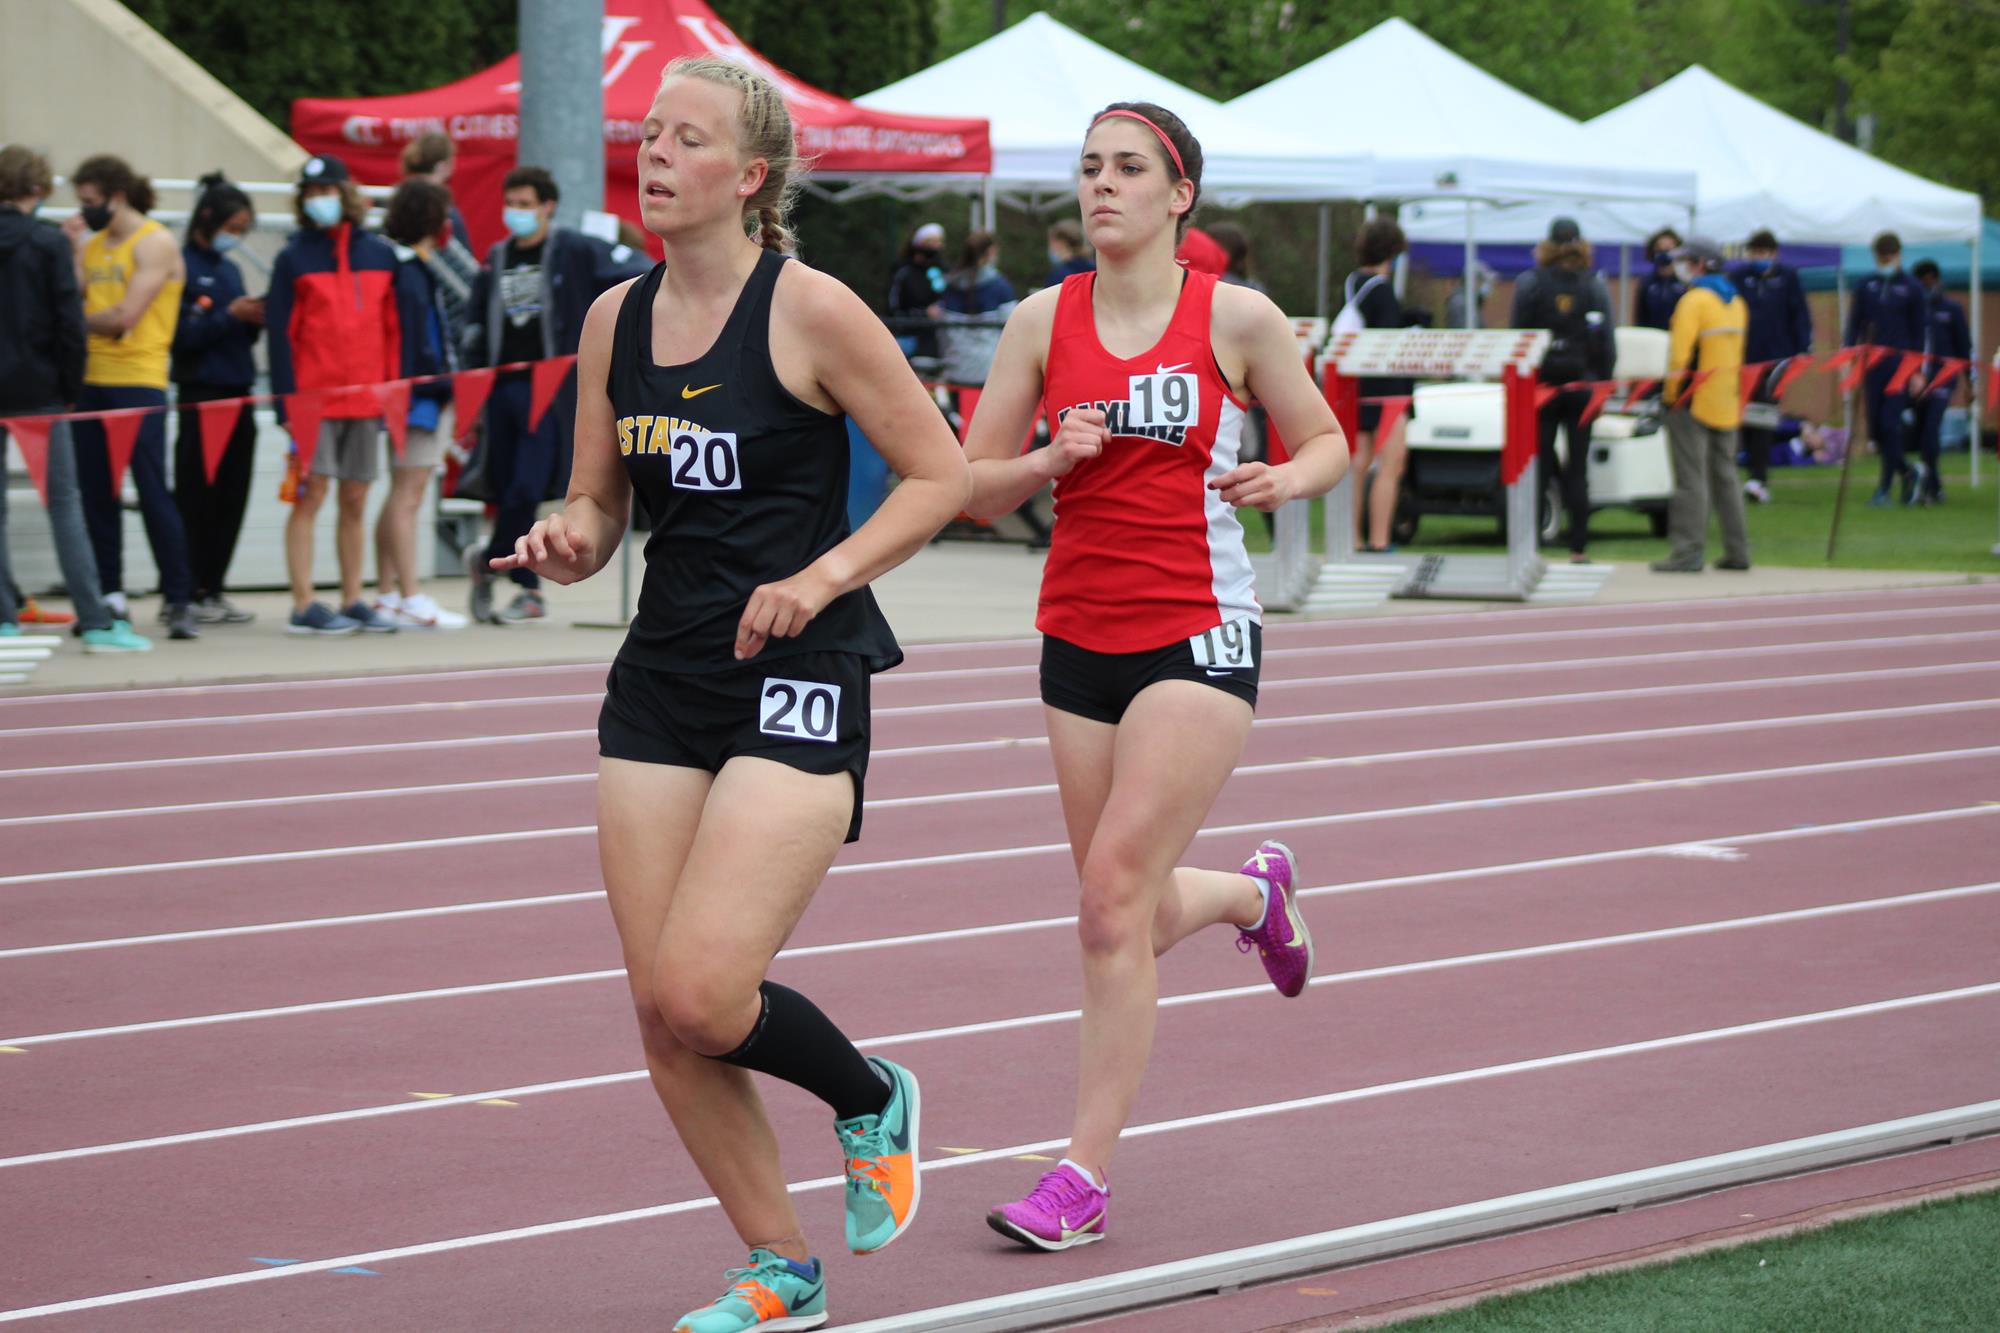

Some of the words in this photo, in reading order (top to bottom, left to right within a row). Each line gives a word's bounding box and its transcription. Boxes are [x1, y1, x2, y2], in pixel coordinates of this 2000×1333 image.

[1134, 375, 1190, 424] 19
[673, 434, 736, 488] 20
[1203, 619, 1244, 665] 19
[762, 683, 835, 738] 20
